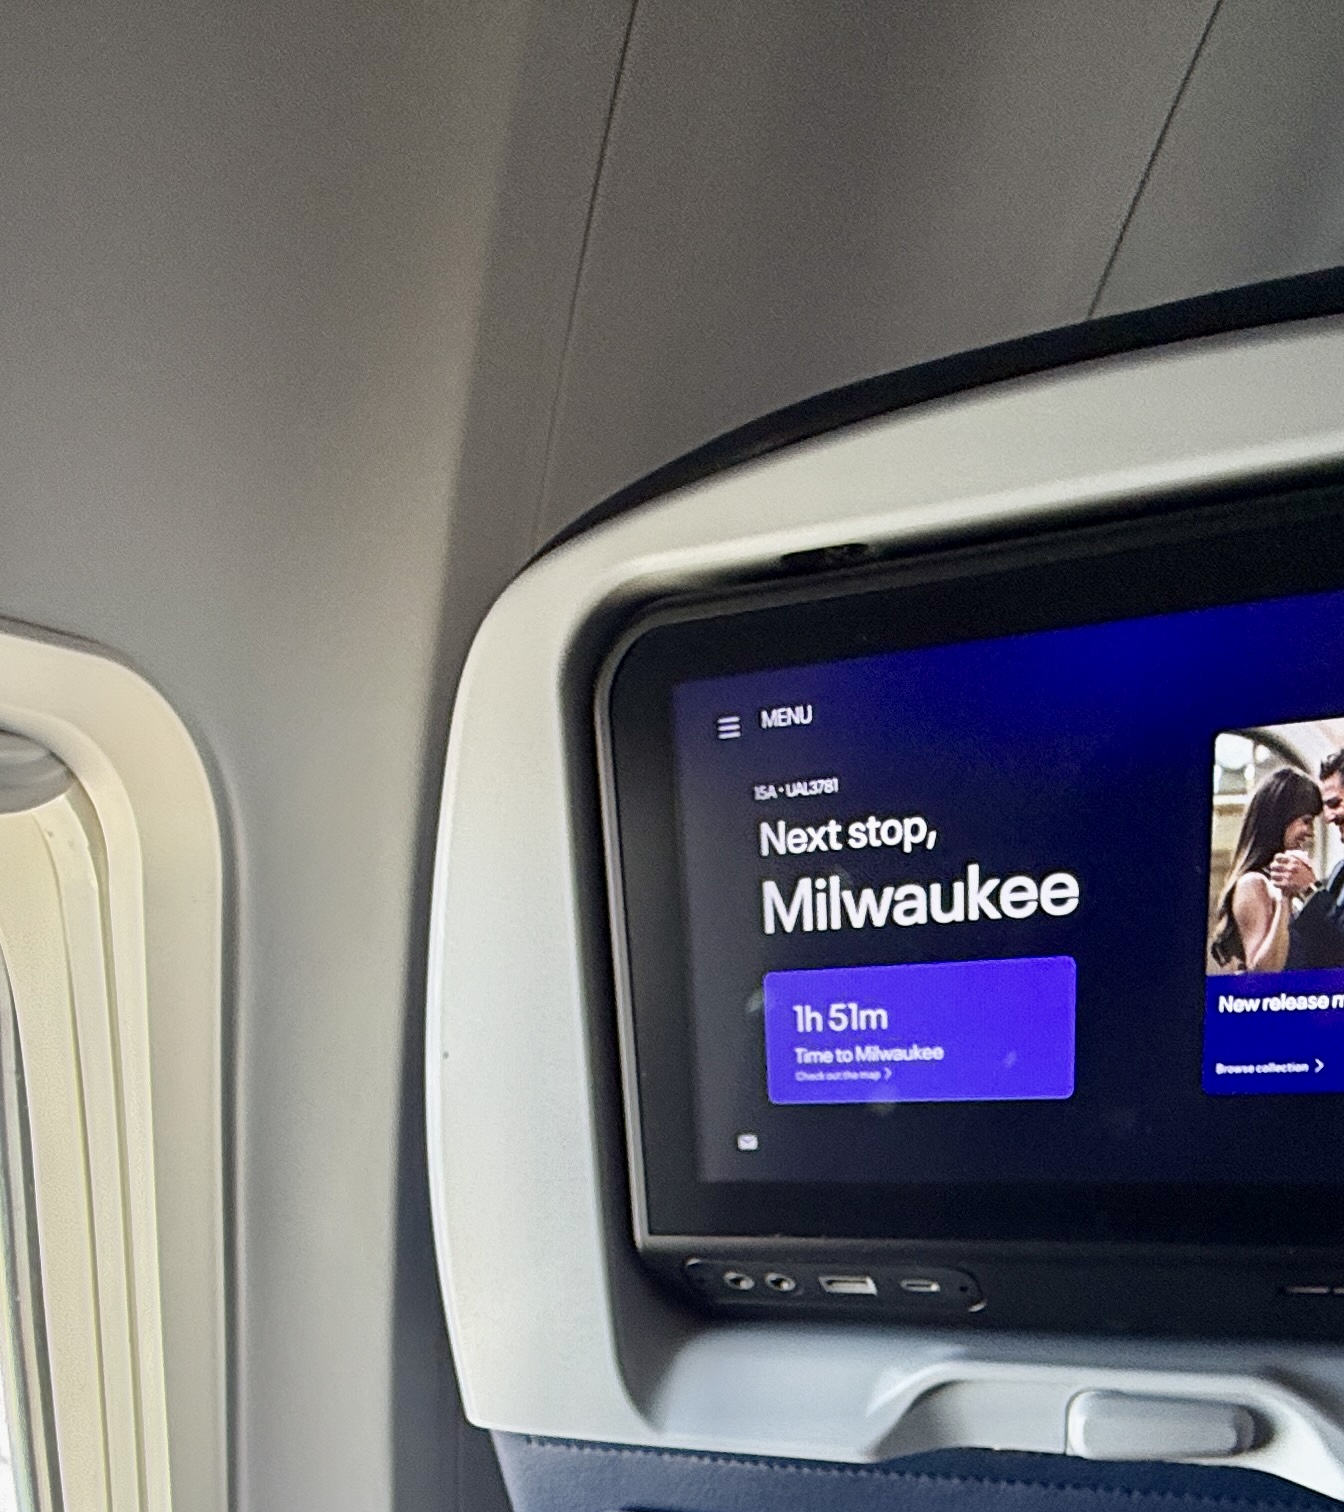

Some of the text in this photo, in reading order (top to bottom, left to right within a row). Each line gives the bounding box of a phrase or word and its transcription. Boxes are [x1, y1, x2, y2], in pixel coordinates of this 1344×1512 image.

[760, 704, 813, 729] MENU
[753, 776, 840, 801] 15A UAL3781
[759, 815, 938, 857] Next stop,
[763, 863, 1081, 935] Milwaukee
[1218, 995, 1261, 1013] New
[1261, 993, 1330, 1011] release
[792, 1002, 889, 1033] 1h 51m
[794, 1043, 945, 1065] Time to Milwaukee
[1215, 1061, 1310, 1075] Browse collection
